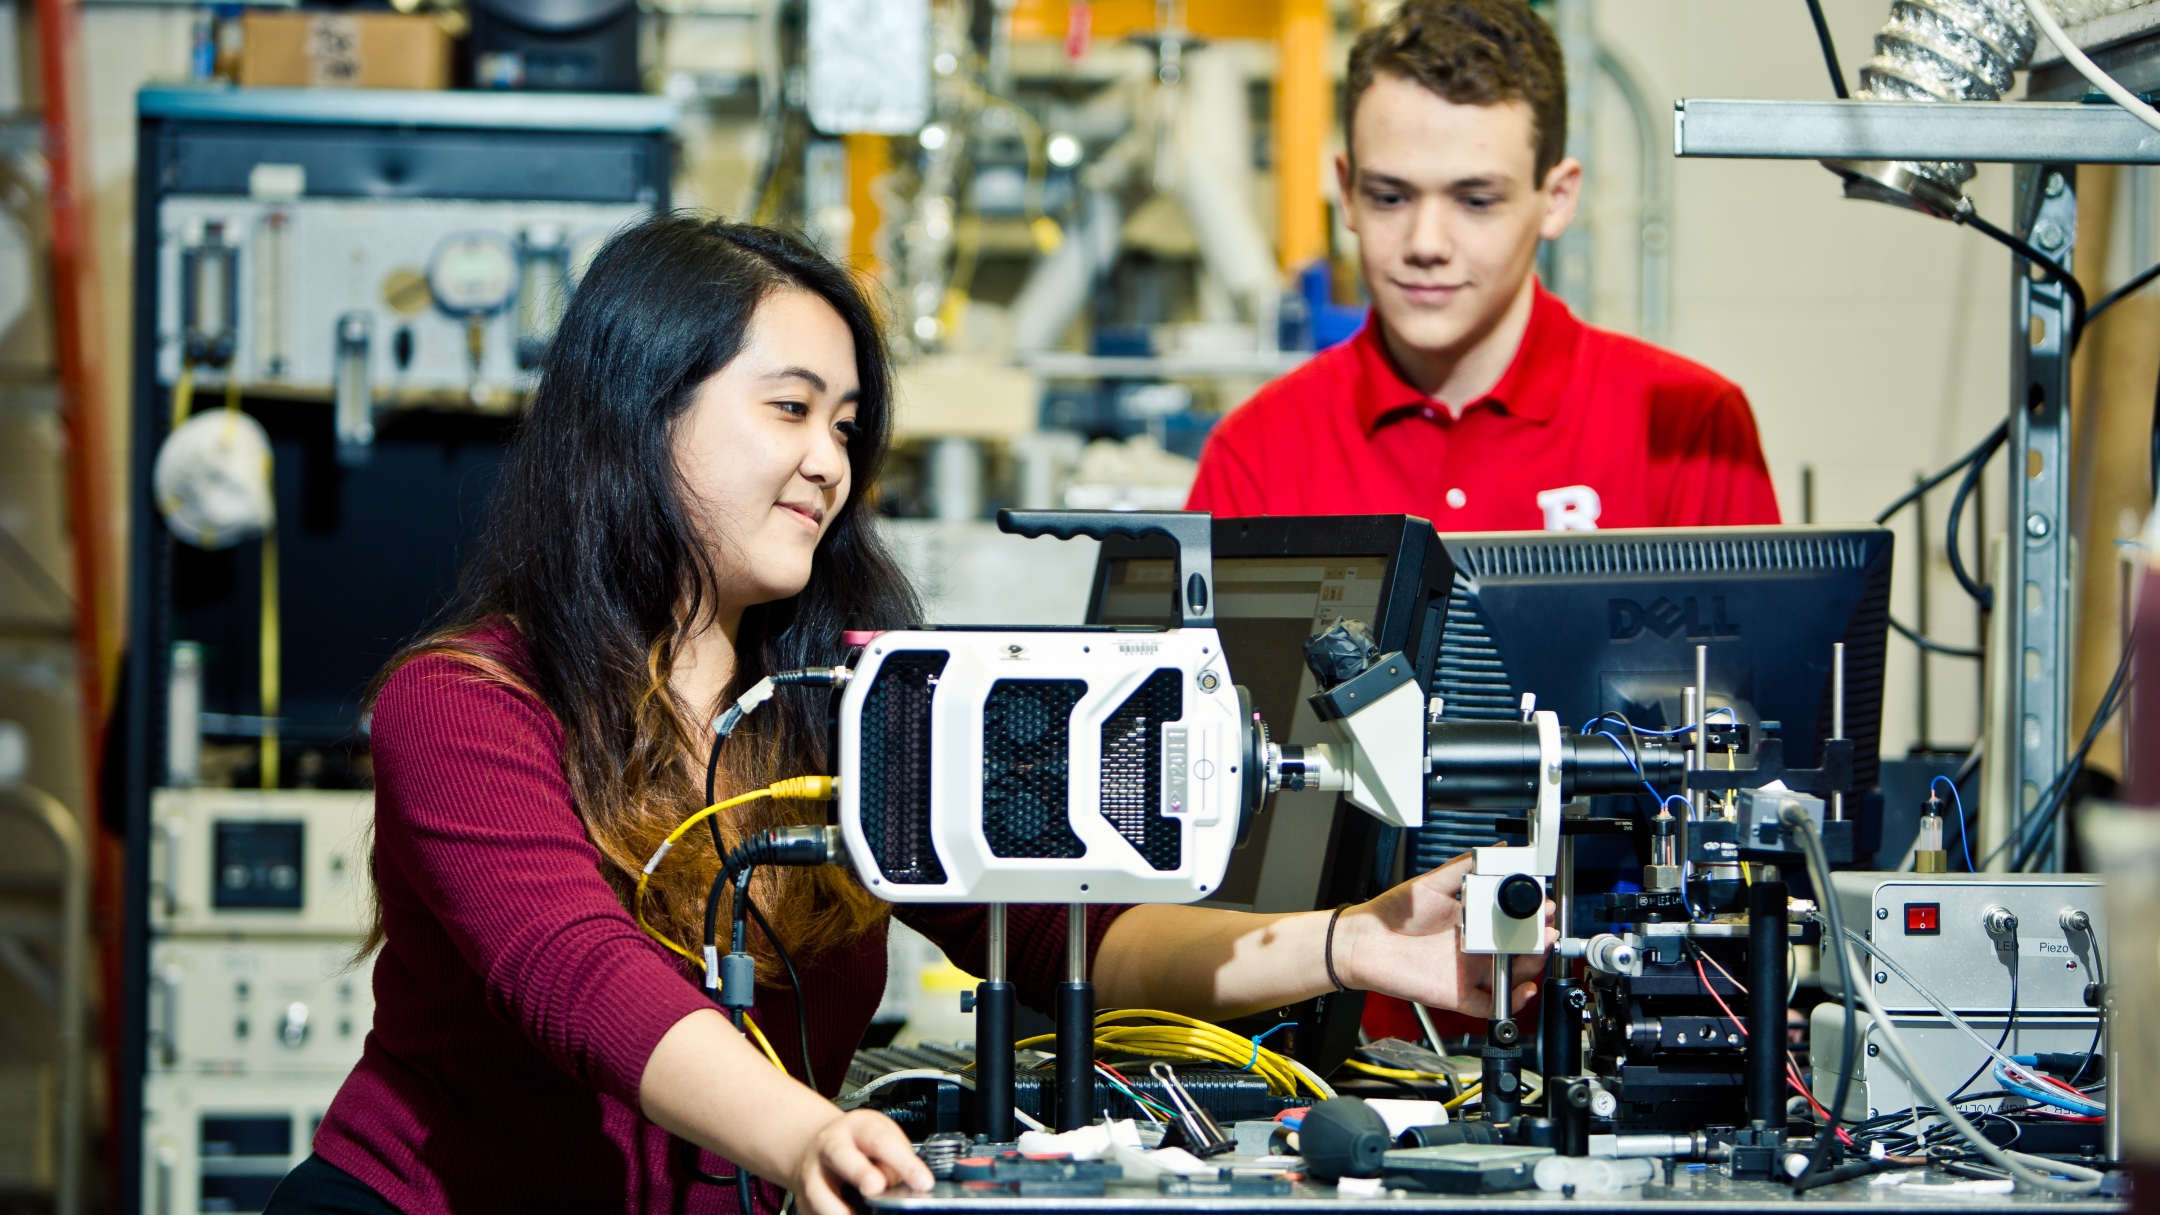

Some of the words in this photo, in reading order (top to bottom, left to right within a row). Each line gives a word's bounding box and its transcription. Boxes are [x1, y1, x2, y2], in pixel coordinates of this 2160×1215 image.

[1608, 595, 1741, 643] DELL
[1168, 732, 1186, 787] v2011
[2039, 942, 2069, 953] Piezo
